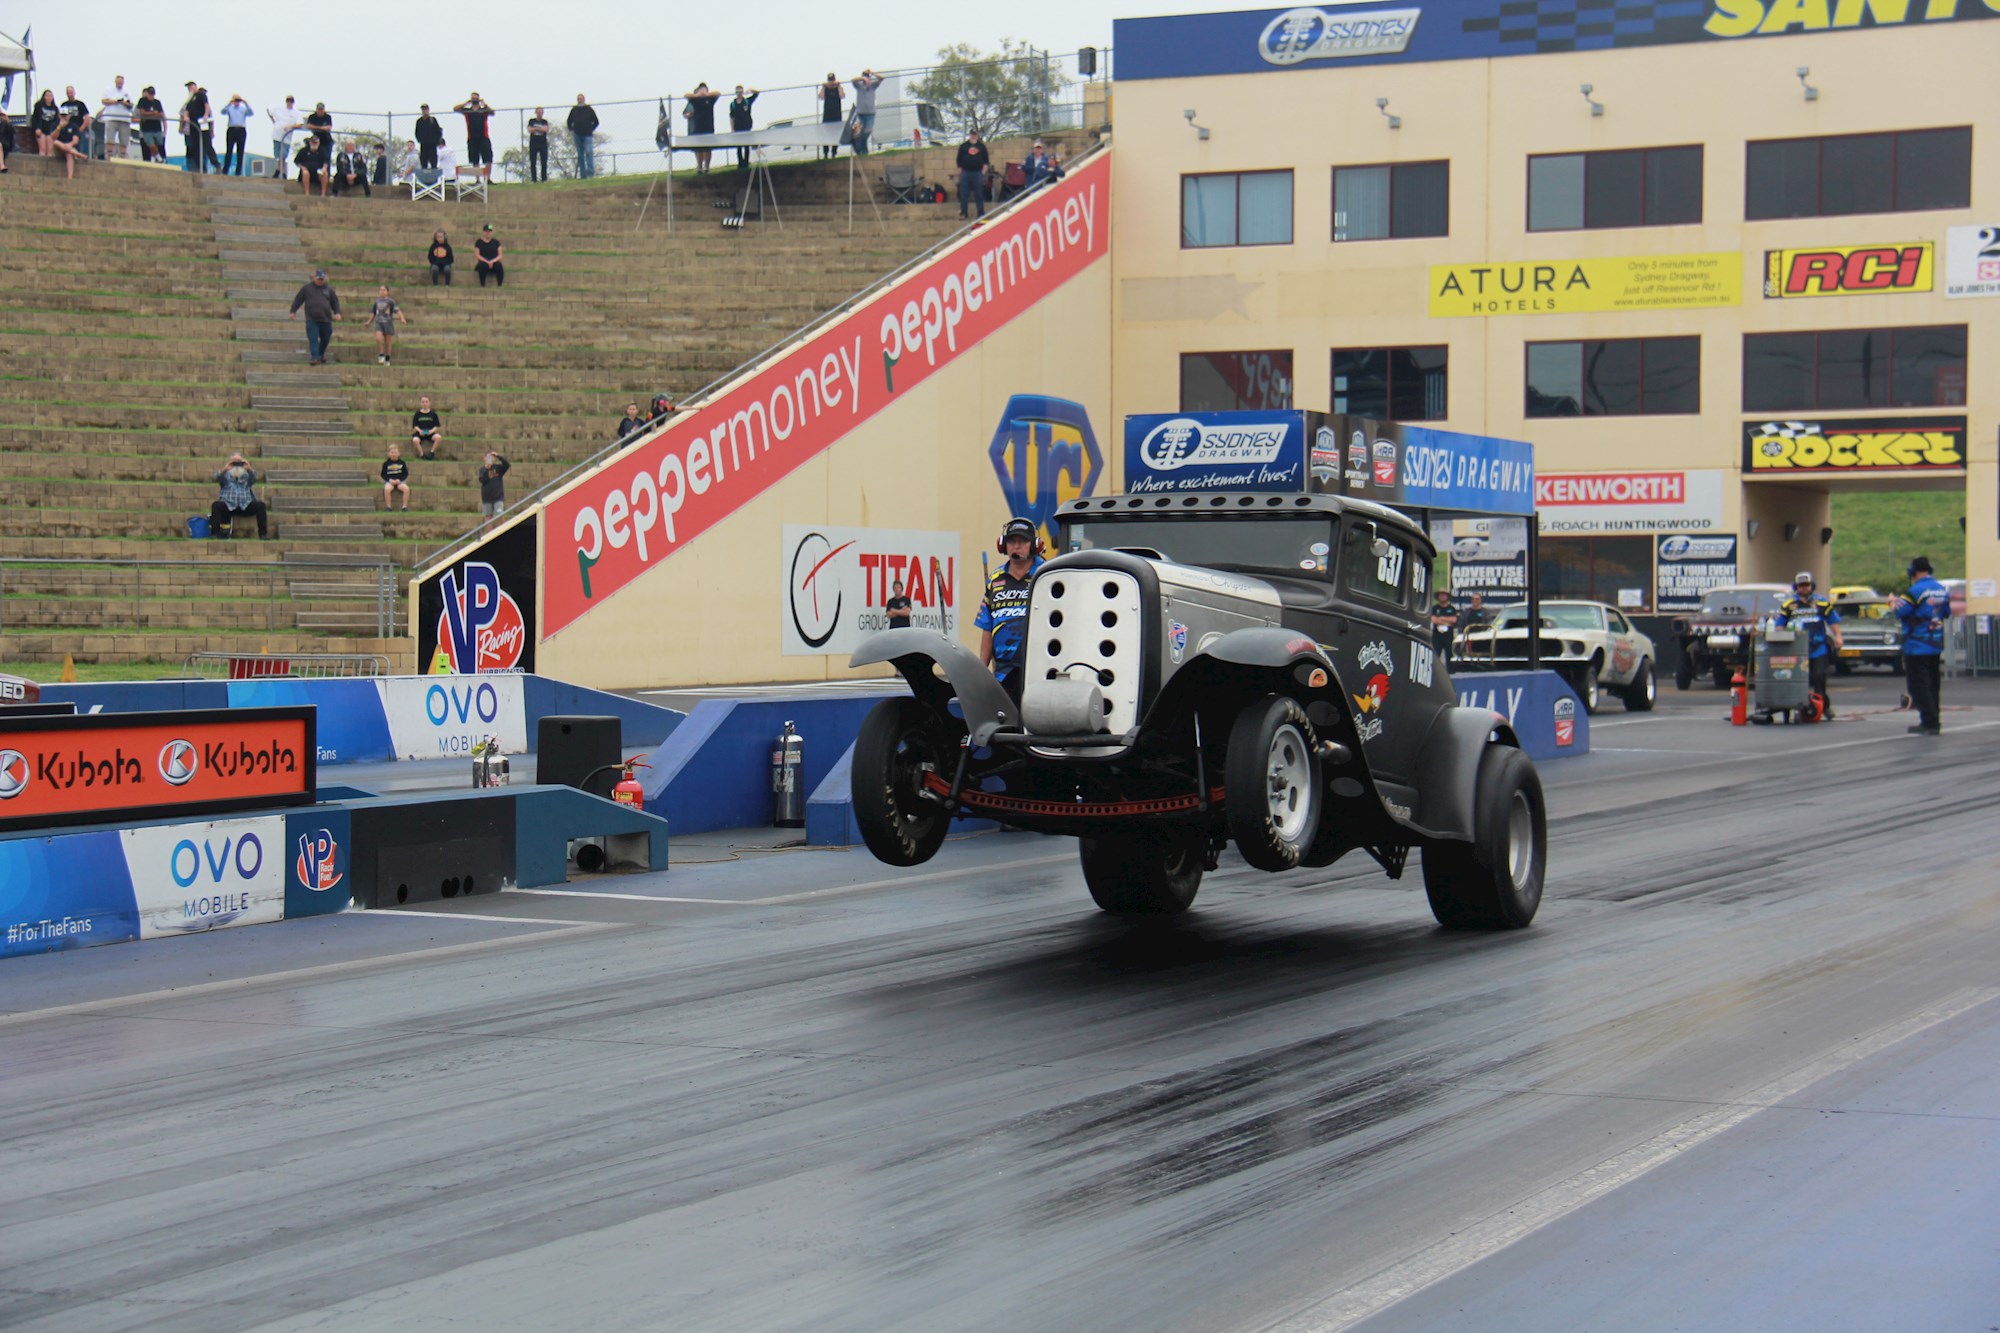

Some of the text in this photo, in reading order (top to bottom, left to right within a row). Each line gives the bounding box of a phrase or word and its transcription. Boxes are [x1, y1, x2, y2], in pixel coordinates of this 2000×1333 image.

[1325, 18, 1411, 40] SYDNEY
[1320, 37, 1403, 50] DRAGWAY
[880, 184, 1096, 393] peppermoney
[1439, 264, 1591, 297] ATURA
[1472, 299, 1557, 312] HOTELS
[1198, 448, 1273, 458] DRAGWAY
[1202, 431, 1282, 449] SYDNEY
[573, 335, 861, 600] peppermoney
[1130, 462, 1298, 494] Where excitement lives!
[1402, 445, 1532, 493] SYDNEY DRAGWAY
[1536, 477, 1682, 502] KENWORTH
[1552, 520, 1599, 531] ROACH
[1604, 519, 1711, 531] HUNTINGWOOD
[859, 553, 954, 608] TITAN
[1451, 565, 1524, 578] ADVERTISE
[1453, 577, 1524, 589] WITH US
[1675, 576, 1737, 588] EXHIBITION
[1683, 564, 1707, 577] YOUR
[1708, 564, 1736, 577] EVENT
[991, 600, 1027, 610] DRAGWA
[993, 589, 1030, 602] SYDNE
[439, 561, 501, 674] VP
[479, 623, 522, 667] Racing
[0, 681, 25, 700] ED
[426, 682, 498, 726] OVO
[204, 739, 296, 778] Kubota
[171, 831, 263, 888] OVO
[299, 828, 334, 890] VP
[183, 891, 250, 918] MOBILE
[7, 915, 93, 945] #ForTheFans
